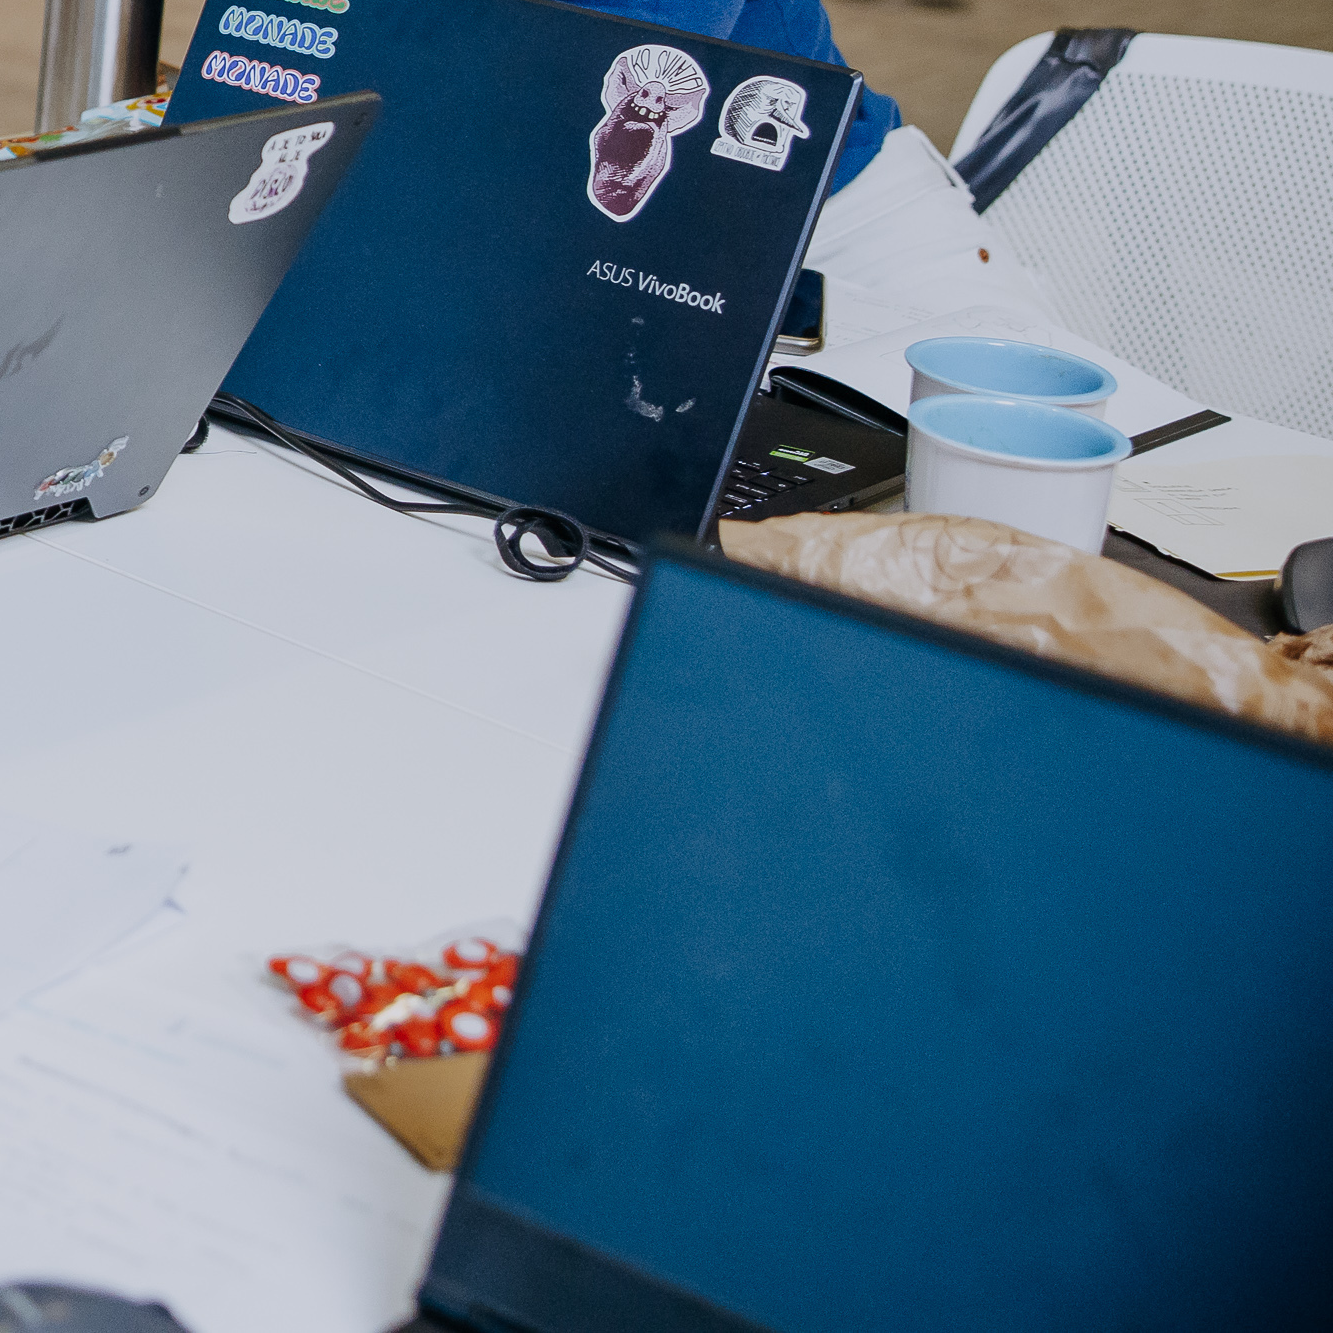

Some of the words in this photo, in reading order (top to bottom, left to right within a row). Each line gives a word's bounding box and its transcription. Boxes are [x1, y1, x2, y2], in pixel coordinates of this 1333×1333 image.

[220, 7, 337, 57] MONADE
[202, 52, 319, 103] MONADE
[587, 259, 636, 287] ASUS
[638, 271, 726, 314] VivoBook
